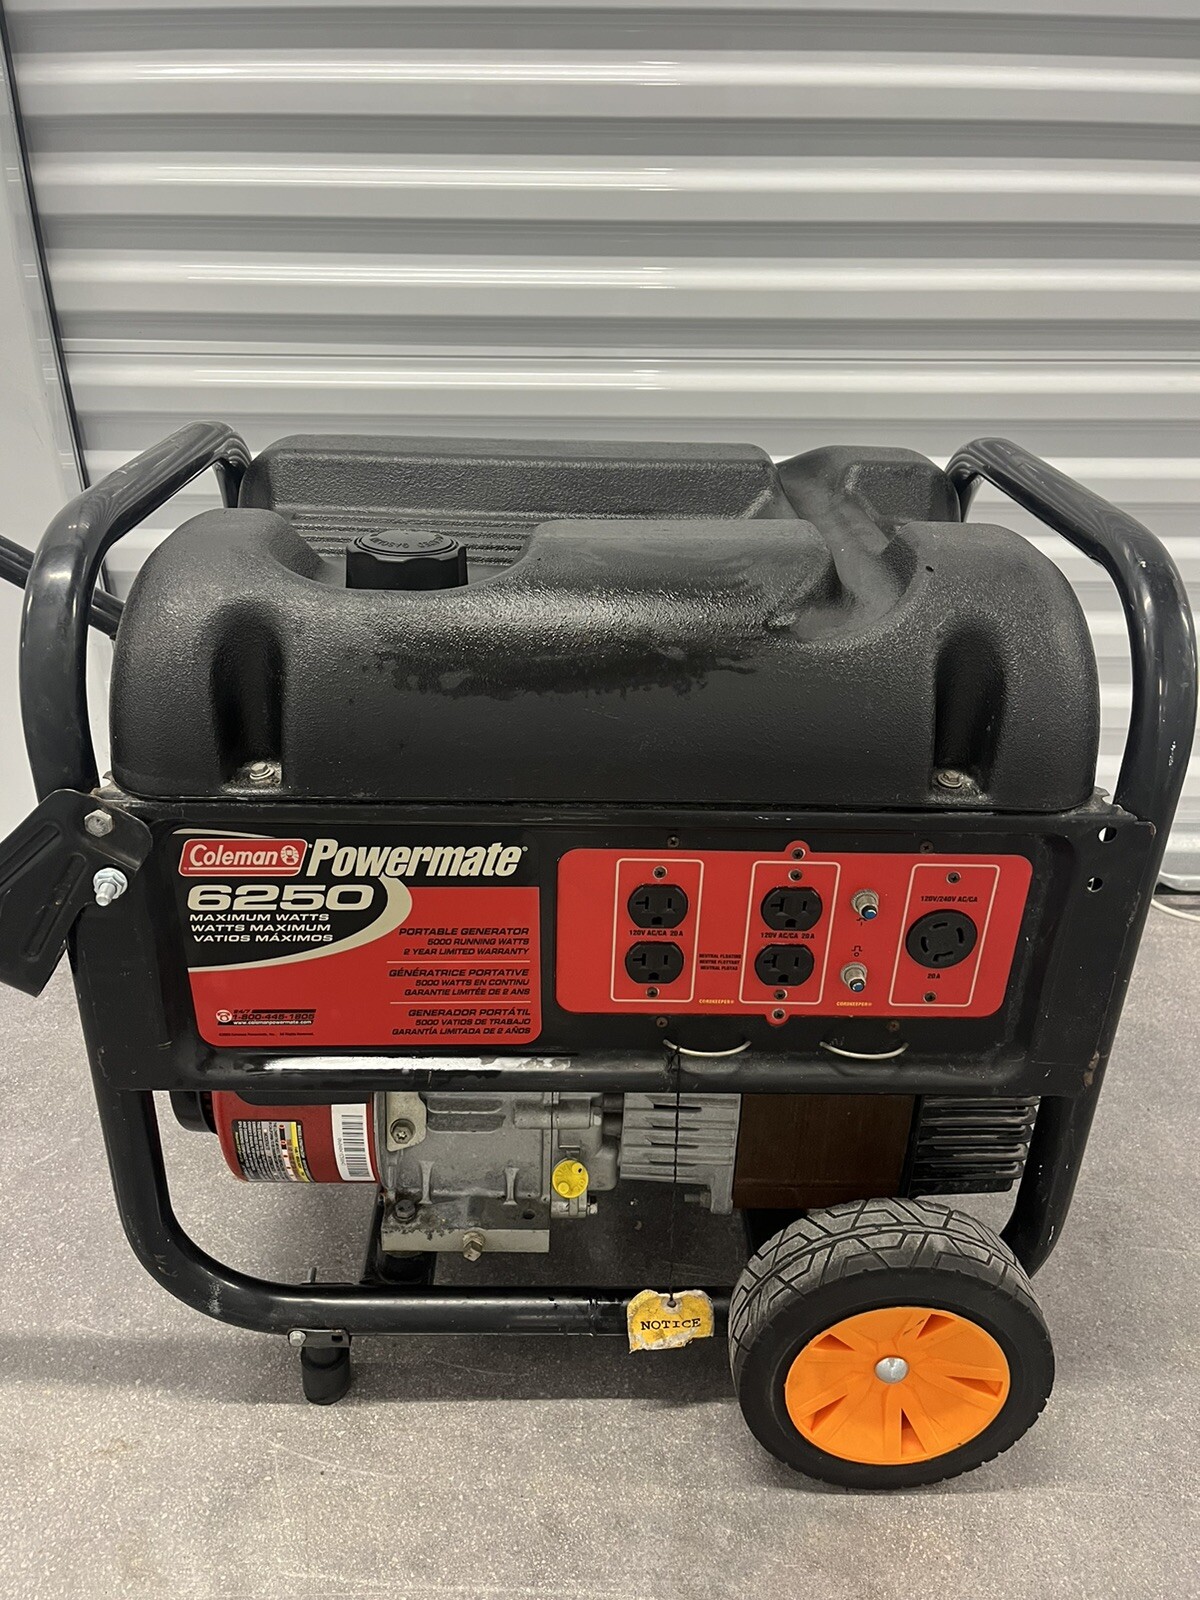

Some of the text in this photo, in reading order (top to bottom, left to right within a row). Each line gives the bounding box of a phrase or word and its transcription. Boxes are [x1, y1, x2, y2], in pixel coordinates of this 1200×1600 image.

[189, 844, 279, 867] Coleman
[306, 839, 522, 877] Powermate
[187, 884, 375, 911] 6250
[189, 913, 330, 922] MAXIMUM WATTS
[191, 924, 331, 932] WATTS MAXIMUM
[398, 927, 530, 936] PORTABLE GENERATOR
[193, 932, 334, 943] VATIOS MÁXIMOS
[646, 929, 668, 938] AC/CA
[777, 932, 799, 940] AC/CA
[427, 938, 453, 946] 5000
[453, 938, 497, 946] RUNNING
[403, 948, 411, 956] 2
[388, 967, 530, 977] GÉNÉRATRICE PORTATIVE
[404, 988, 451, 996] GARANTIE
[451, 987, 487, 996] LIMITÉE
[510, 988, 531, 996] ANS
[408, 1007, 531, 1017] GENERADOR PORTÁTIL
[489, 1018, 531, 1026] TRABAJO
[391, 1026, 438, 1035] GARANTÍA
[504, 1026, 531, 1035] AÑOS
[640, 1317, 702, 1331] NOTICE
